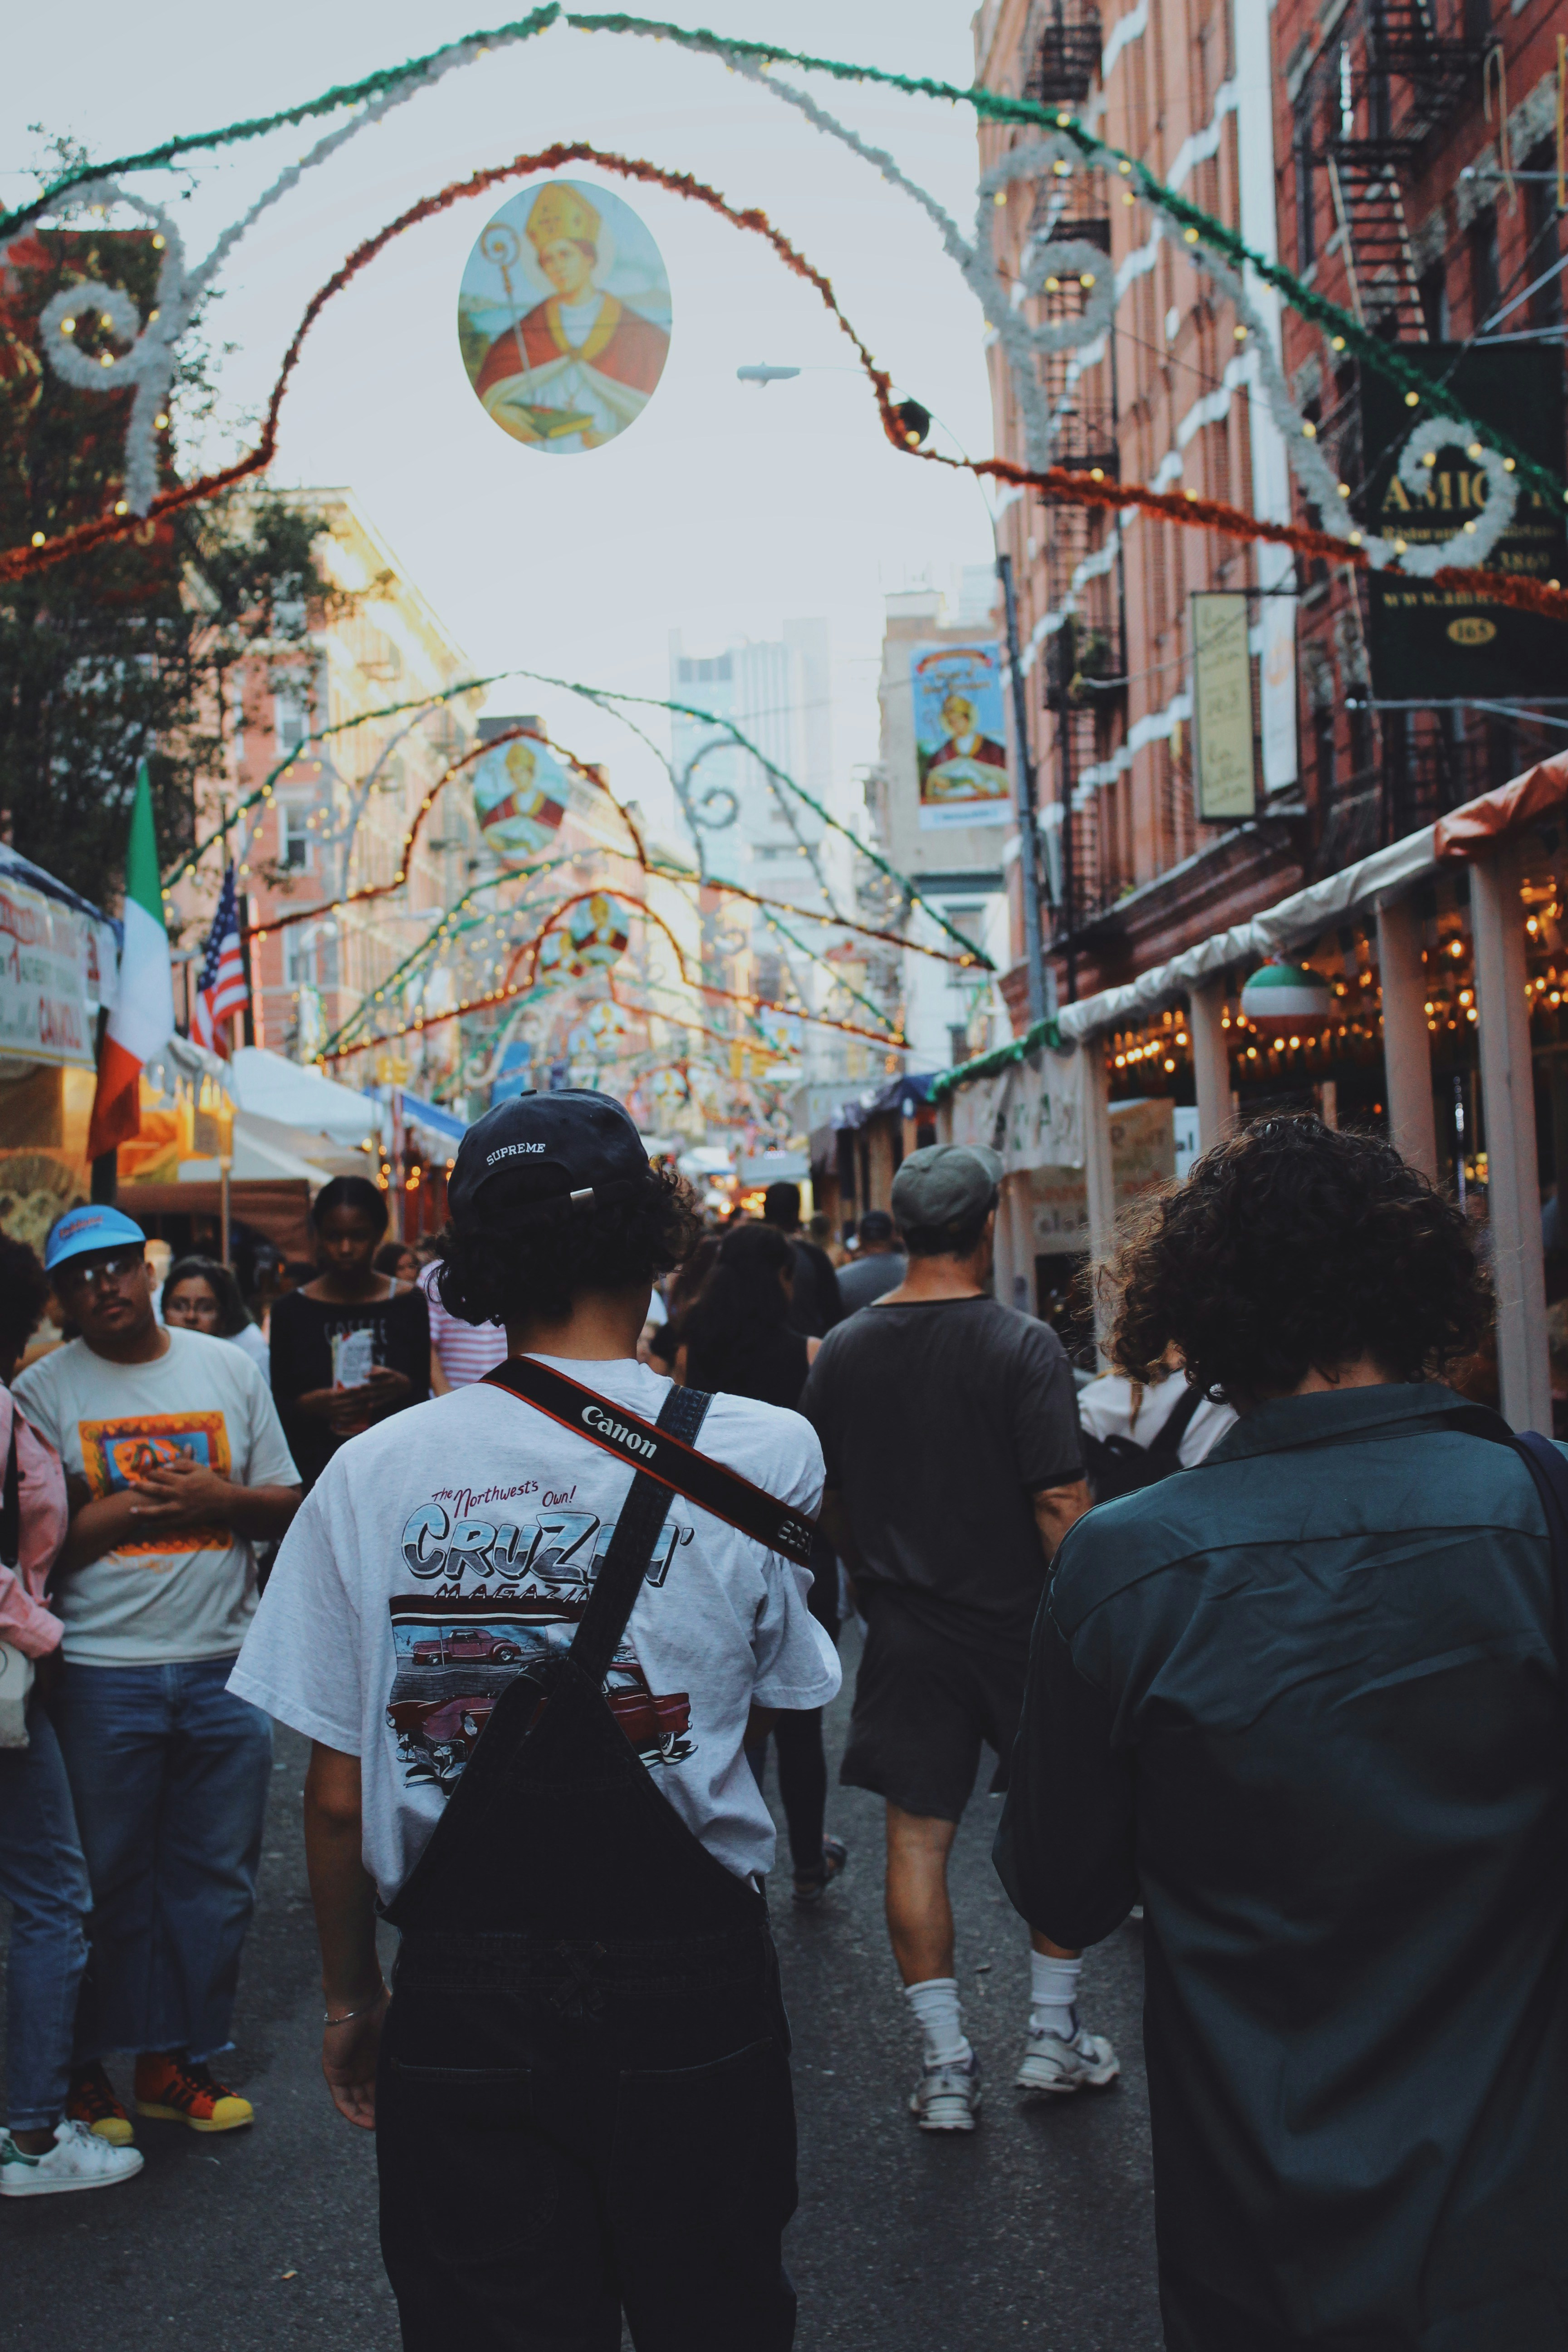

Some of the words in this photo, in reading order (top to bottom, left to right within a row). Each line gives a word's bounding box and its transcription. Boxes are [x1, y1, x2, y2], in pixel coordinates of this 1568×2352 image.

[486, 1142, 546, 1166] SUPREME
[581, 1406, 657, 1459] Canon
[431, 1487, 453, 1502] The
[454, 1480, 539, 1518] Northwest's
[542, 1485, 577, 1507] Own!
[778, 1520, 809, 1550] EOS
[434, 1583, 591, 1603] MAGAZIN
